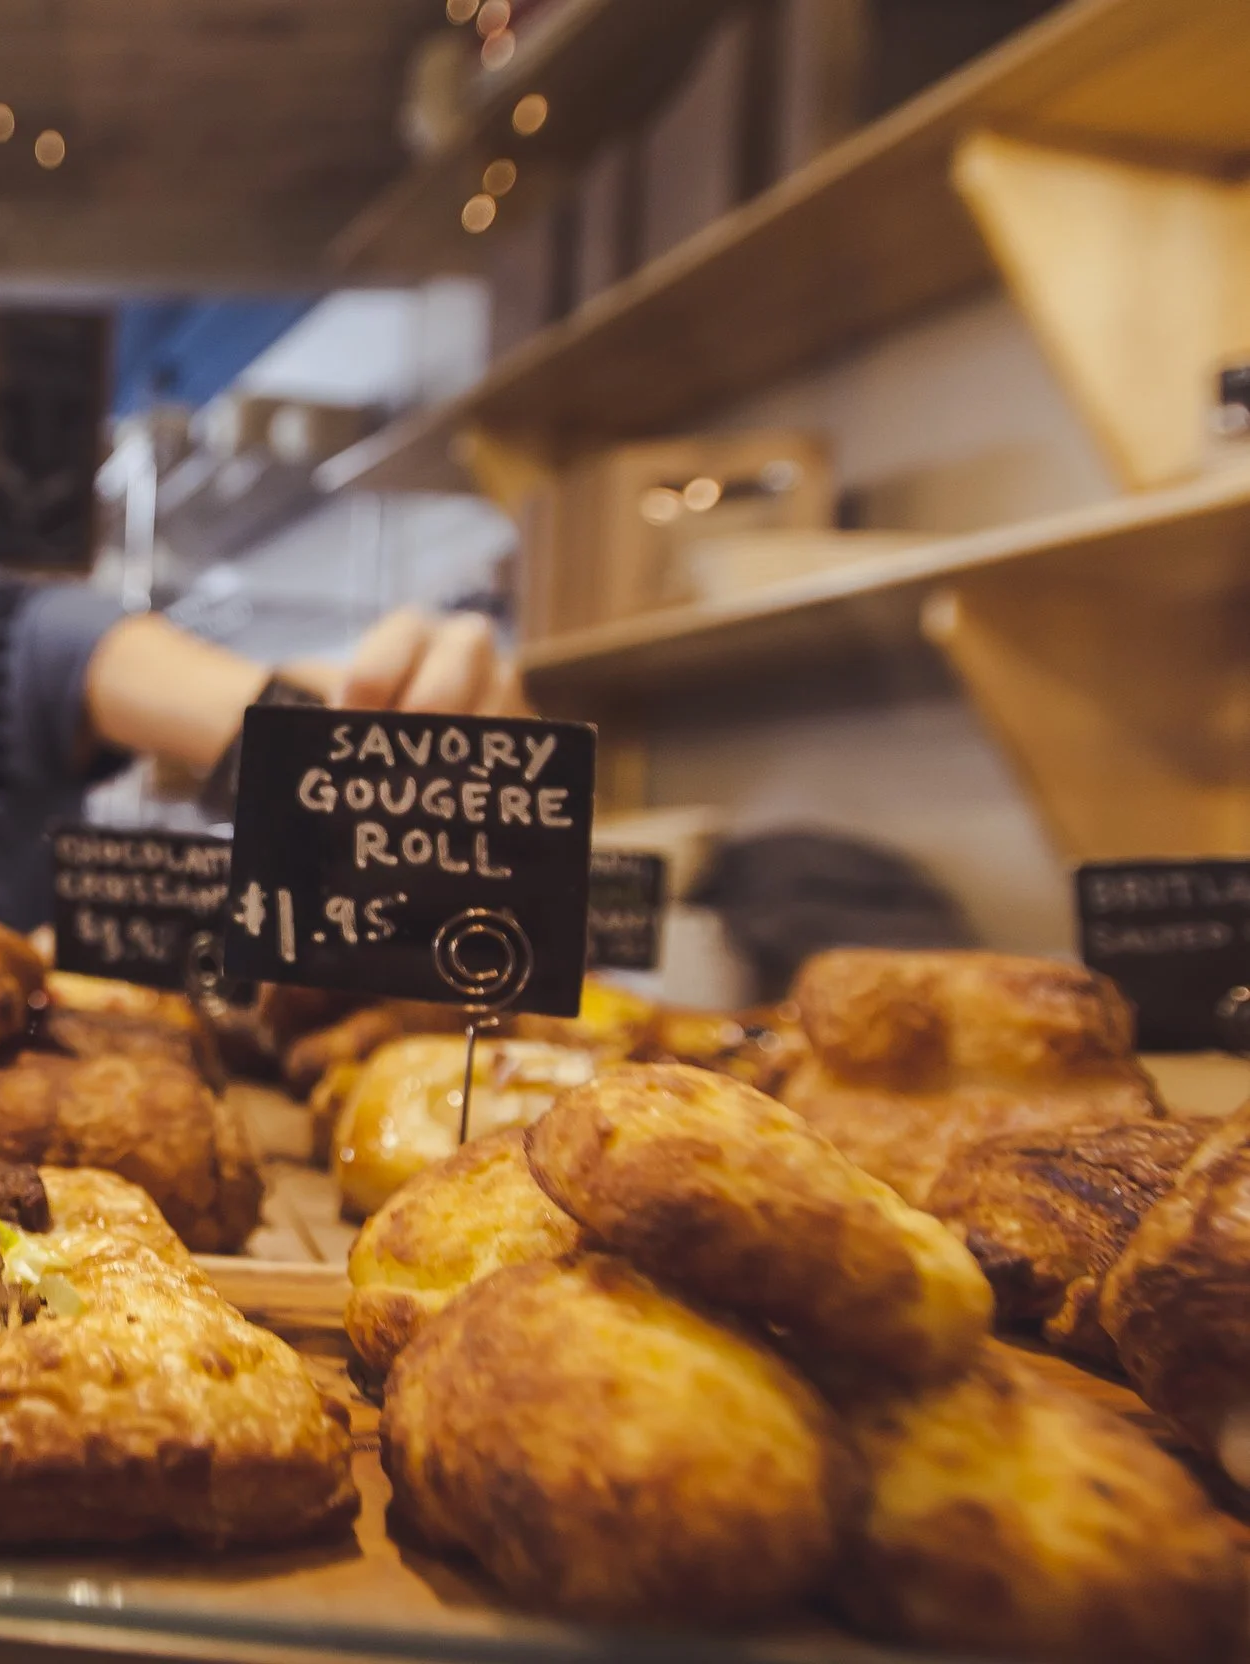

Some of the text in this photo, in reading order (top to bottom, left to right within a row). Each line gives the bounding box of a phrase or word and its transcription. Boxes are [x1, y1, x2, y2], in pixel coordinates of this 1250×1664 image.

[329, 721, 558, 782] SAVORY
[354, 820, 513, 880] ROLL
[233, 880, 408, 963] $1.95
